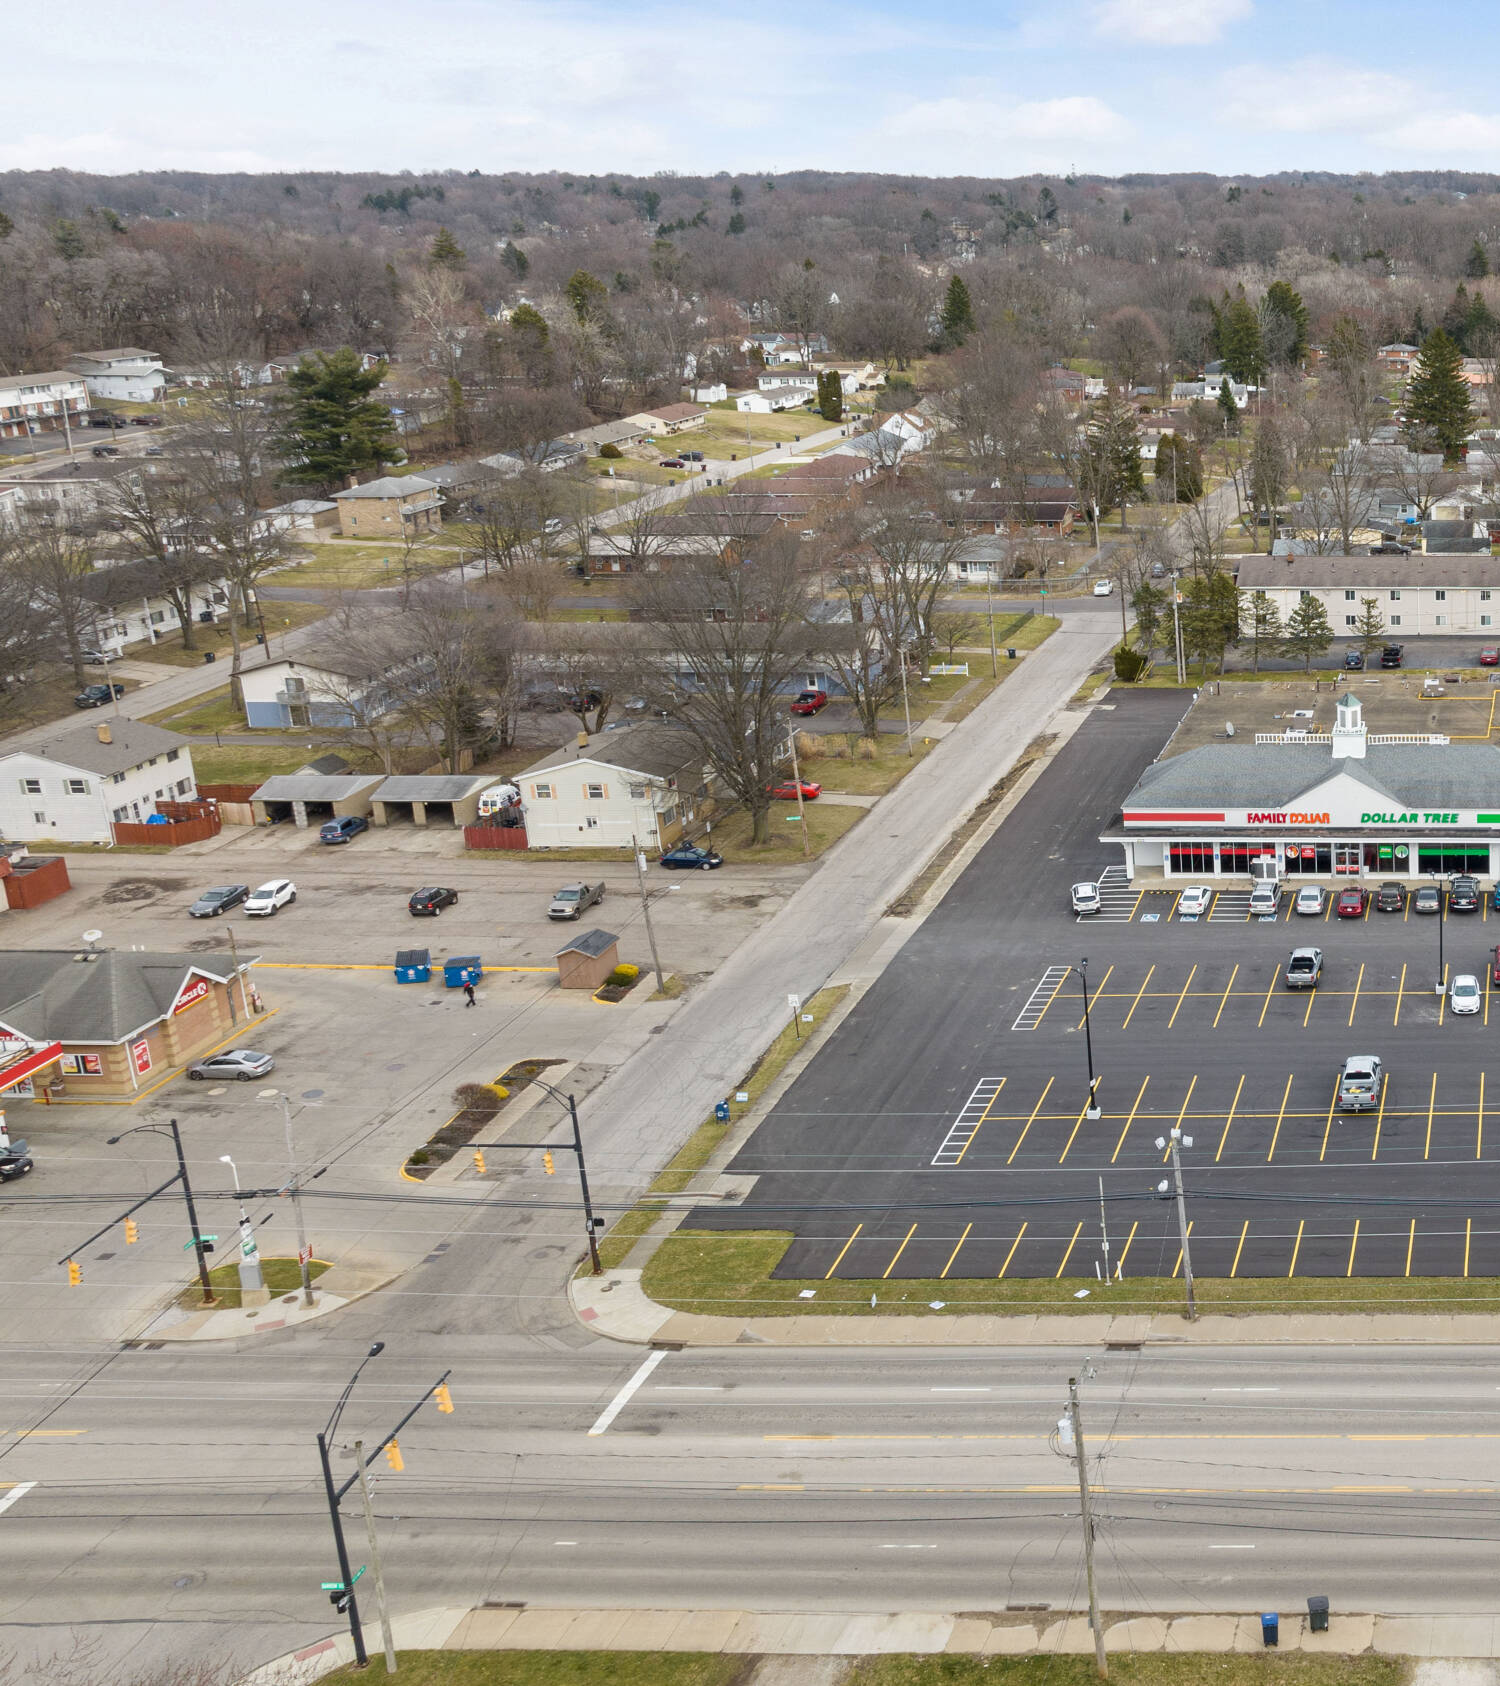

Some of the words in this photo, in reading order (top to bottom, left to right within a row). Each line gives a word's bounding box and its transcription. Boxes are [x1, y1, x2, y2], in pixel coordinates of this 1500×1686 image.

[1247, 813, 1287, 824] FAMILY
[1289, 813, 1330, 824] DOLLAR
[1360, 813, 1419, 824] DOLLAR
[1423, 813, 1459, 824] TREE
